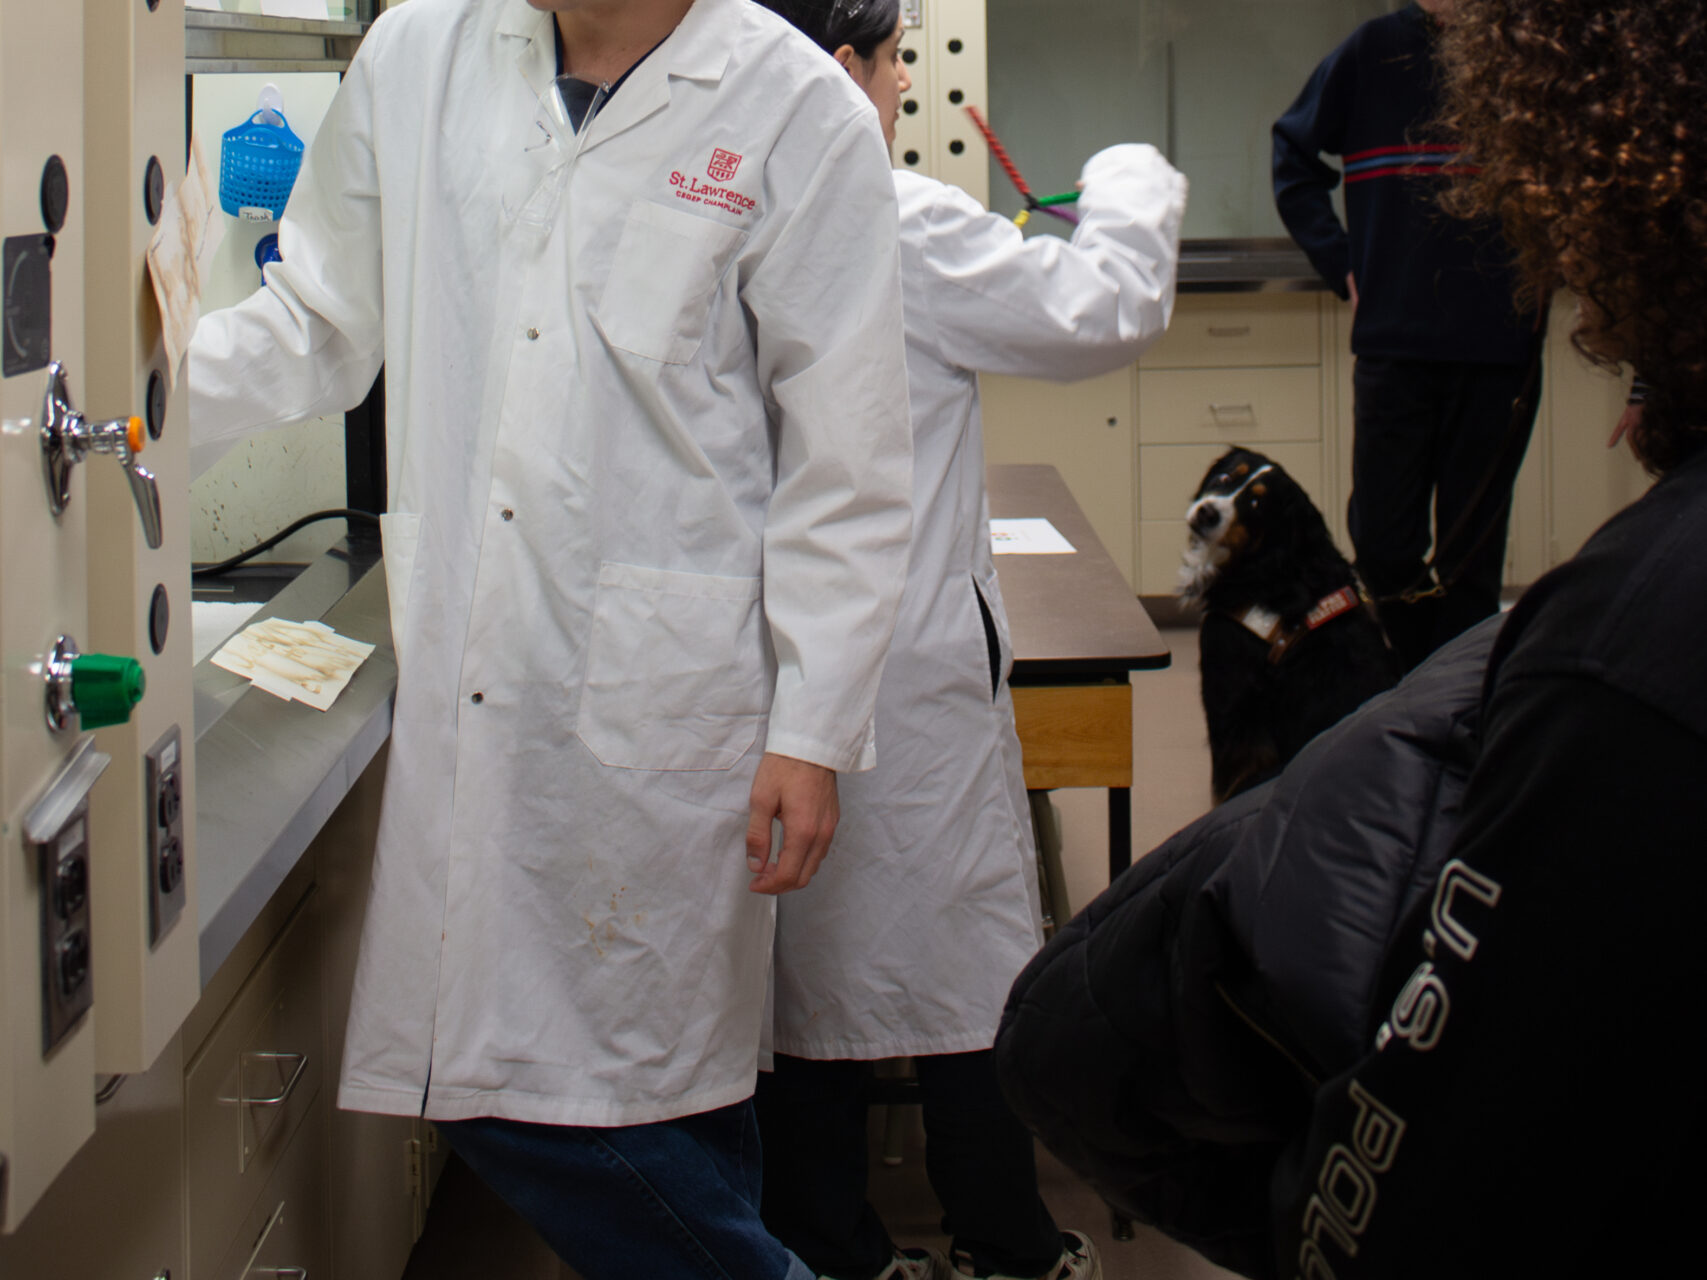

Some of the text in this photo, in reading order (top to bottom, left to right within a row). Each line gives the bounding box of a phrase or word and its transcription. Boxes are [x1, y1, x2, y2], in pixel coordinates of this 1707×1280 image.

[669, 170, 756, 210] St. Lawrence
[243, 211, 271, 222] Trash
[703, 198, 743, 216] CHAMPLAIN
[1375, 858, 1503, 1052] U.S.
